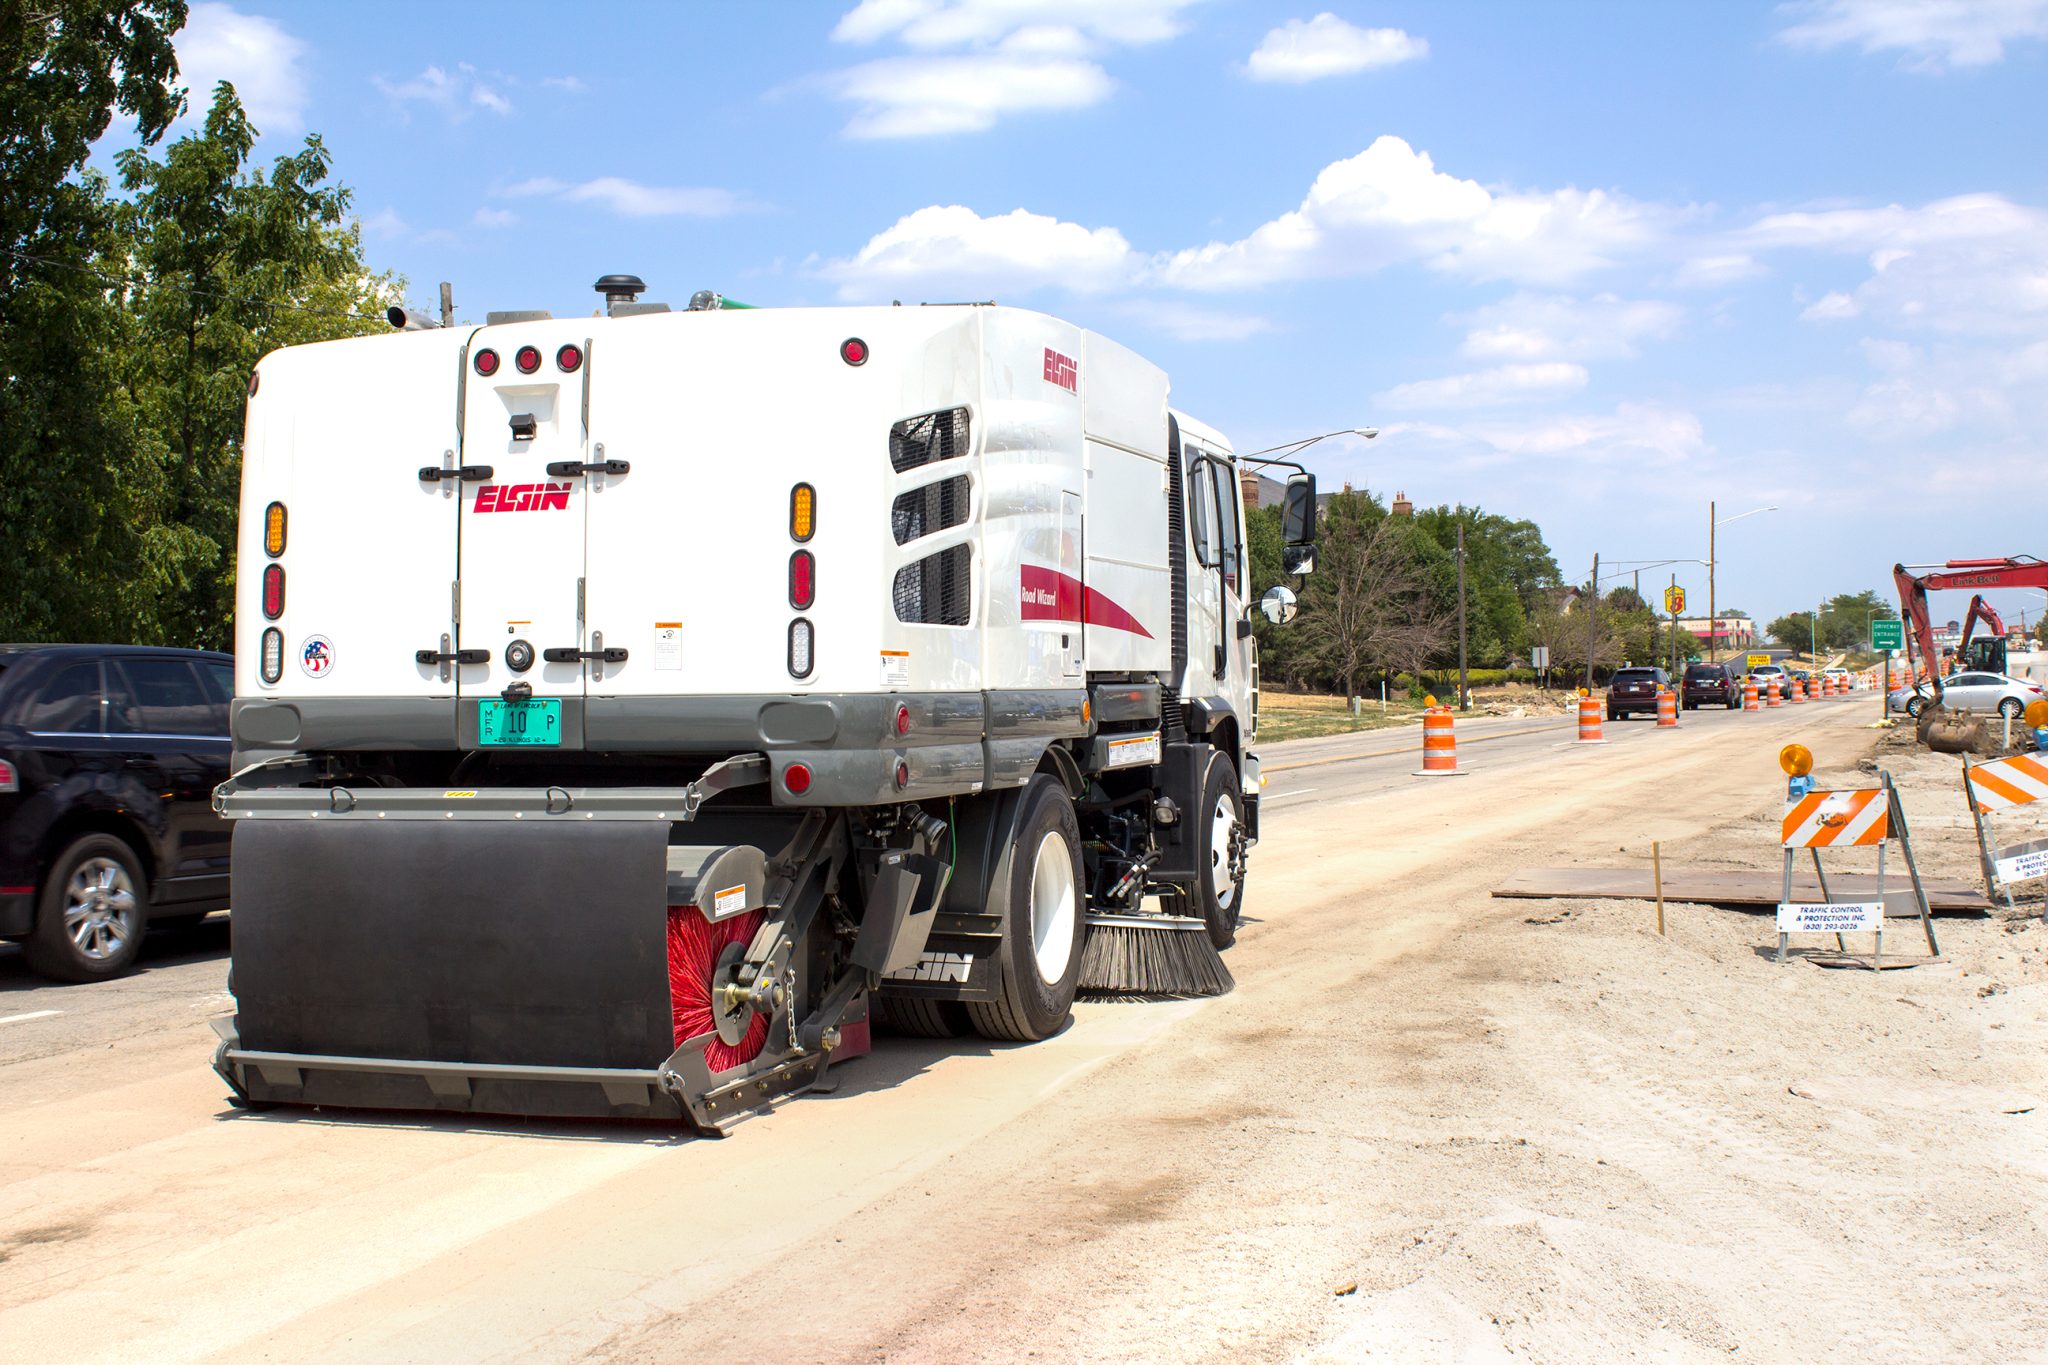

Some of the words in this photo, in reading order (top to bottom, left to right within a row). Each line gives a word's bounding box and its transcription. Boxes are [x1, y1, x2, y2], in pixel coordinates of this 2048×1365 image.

[1043, 347, 1077, 392] ELGIN
[473, 482, 572, 513] ELGIN
[1021, 586, 1036, 604] Road
[1037, 588, 1056, 606] Wizard
[485, 710, 493, 735] MFR
[508, 711, 527, 733] 10
[547, 715, 555, 730] P
[2016, 854, 2041, 864] TRAFFIC
